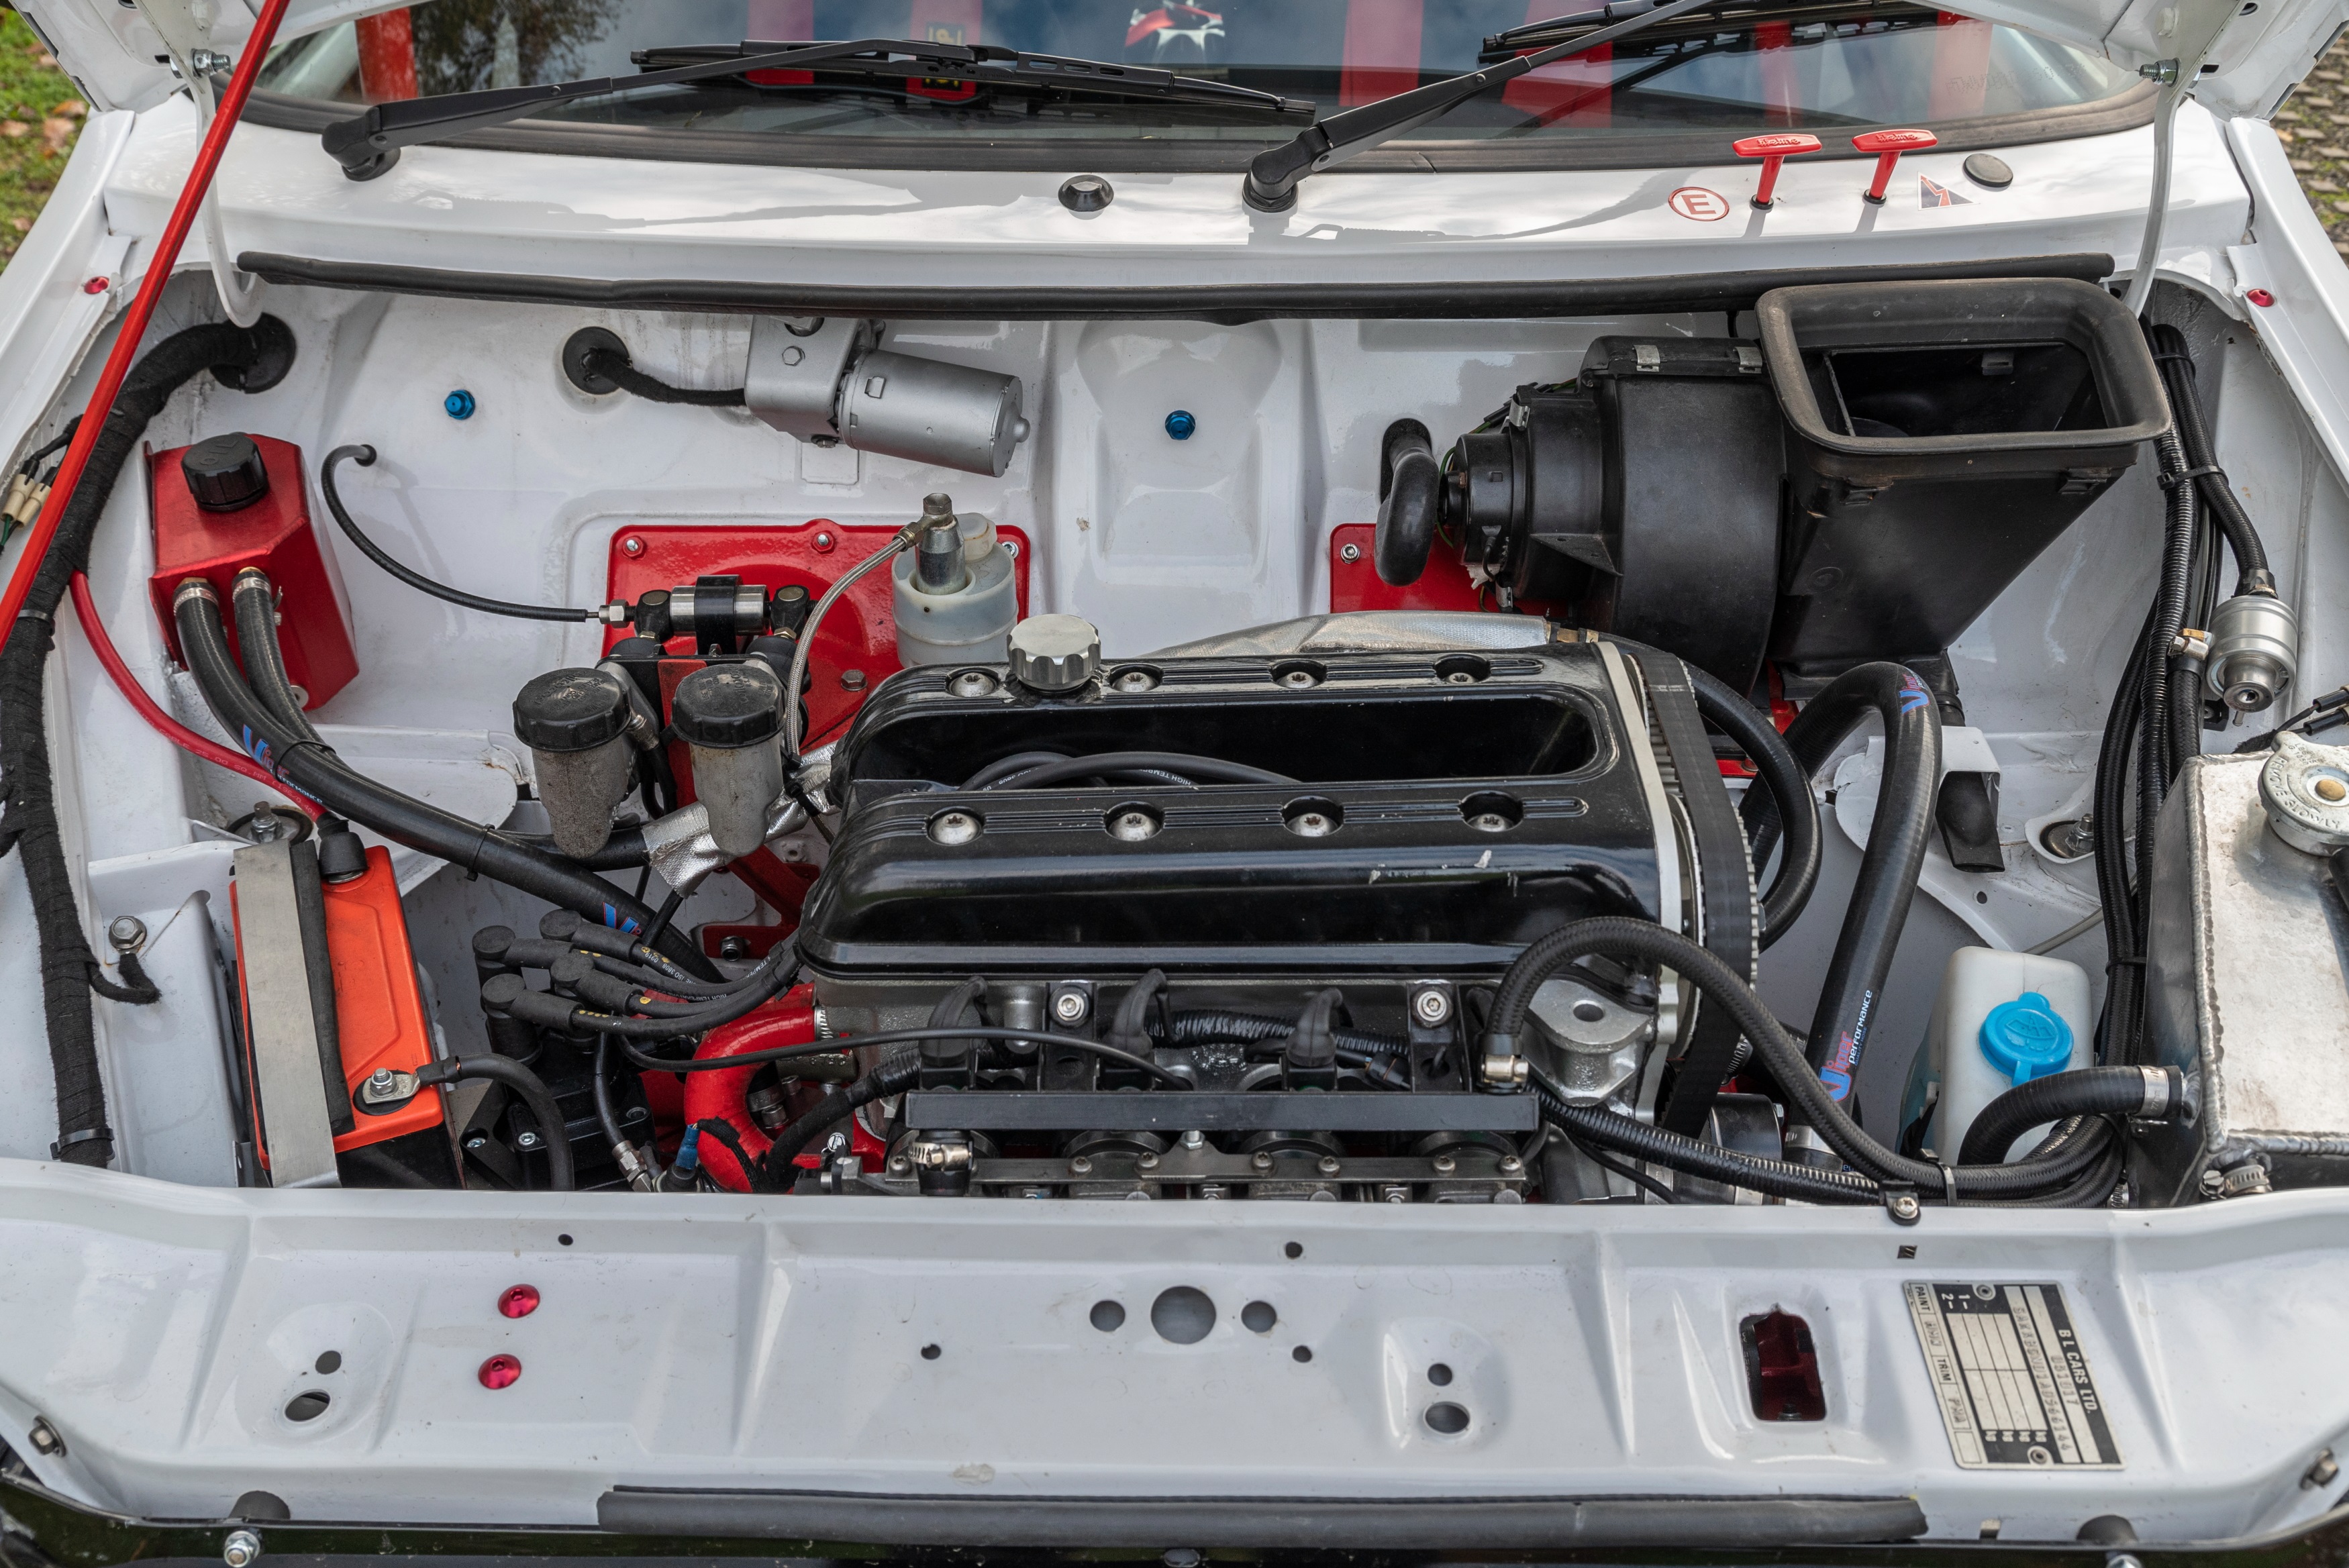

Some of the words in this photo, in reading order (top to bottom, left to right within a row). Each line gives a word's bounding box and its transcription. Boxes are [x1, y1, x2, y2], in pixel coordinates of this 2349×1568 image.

[1681, 193, 1716, 215] E
[1899, 674, 1931, 717] Viper
[1171, 774, 1192, 786] HIGH
[2268, 755, 2289, 797] REMOVE
[2285, 800, 2340, 830] SLOWLY
[645, 952, 659, 963] 0919
[662, 963, 674, 975] 3808
[674, 972, 685, 982] ISO
[1848, 990, 1872, 1064] performance
[1854, 1042, 1863, 1066] QUALITY
[1819, 1031, 1853, 1103] Viper
[1915, 1286, 1931, 1312] PAINT
[1936, 1359, 1952, 1382] TRIM
[2058, 1329, 2070, 1337] B
[2067, 1353, 2088, 1386] CARS
[2080, 1390, 2098, 1414] LTD.
[1985, 1430, 1997, 1443] kg
[2001, 1430, 2014, 1443] kg
[2018, 1430, 2030, 1443] kg
[2035, 1430, 2047, 1443] kg
